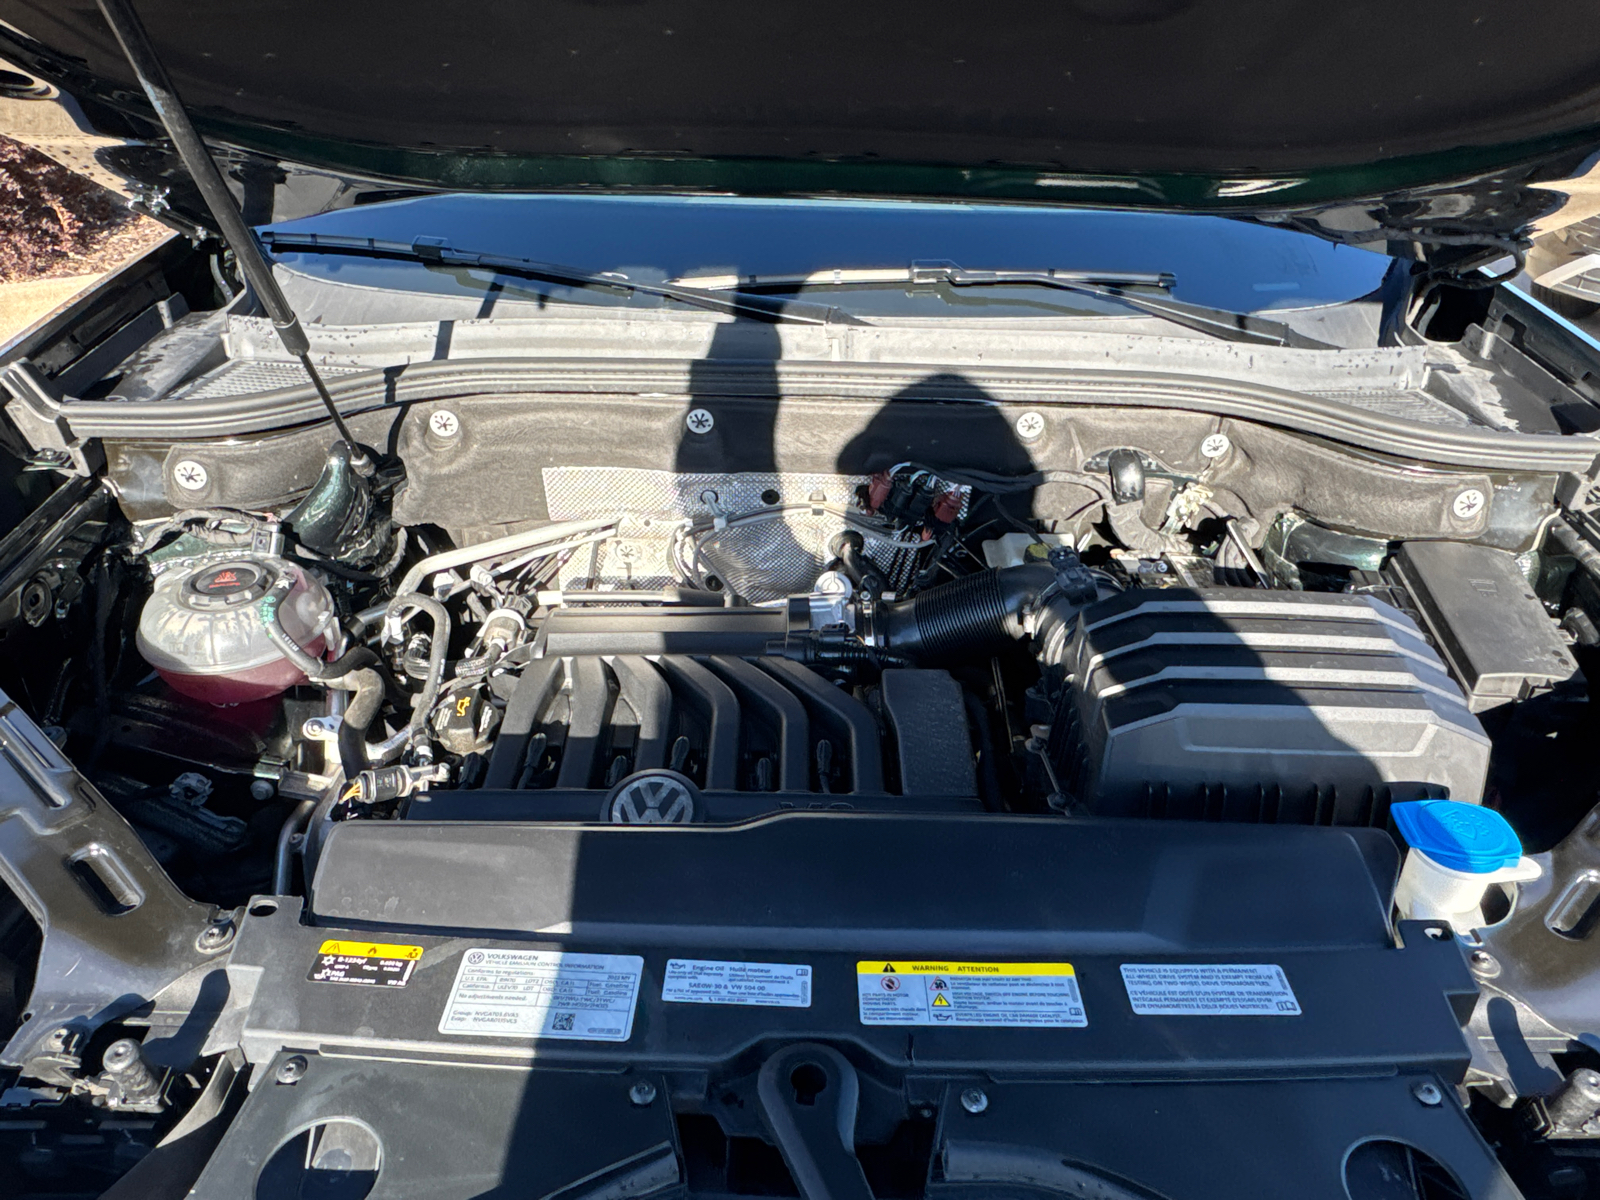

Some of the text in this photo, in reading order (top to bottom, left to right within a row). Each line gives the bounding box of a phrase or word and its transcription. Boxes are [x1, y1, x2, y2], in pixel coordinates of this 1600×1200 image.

[487, 953, 539, 961] VOLKSWAGEN
[692, 964, 714, 972] Engine
[957, 965, 999, 973] ATTENTION
